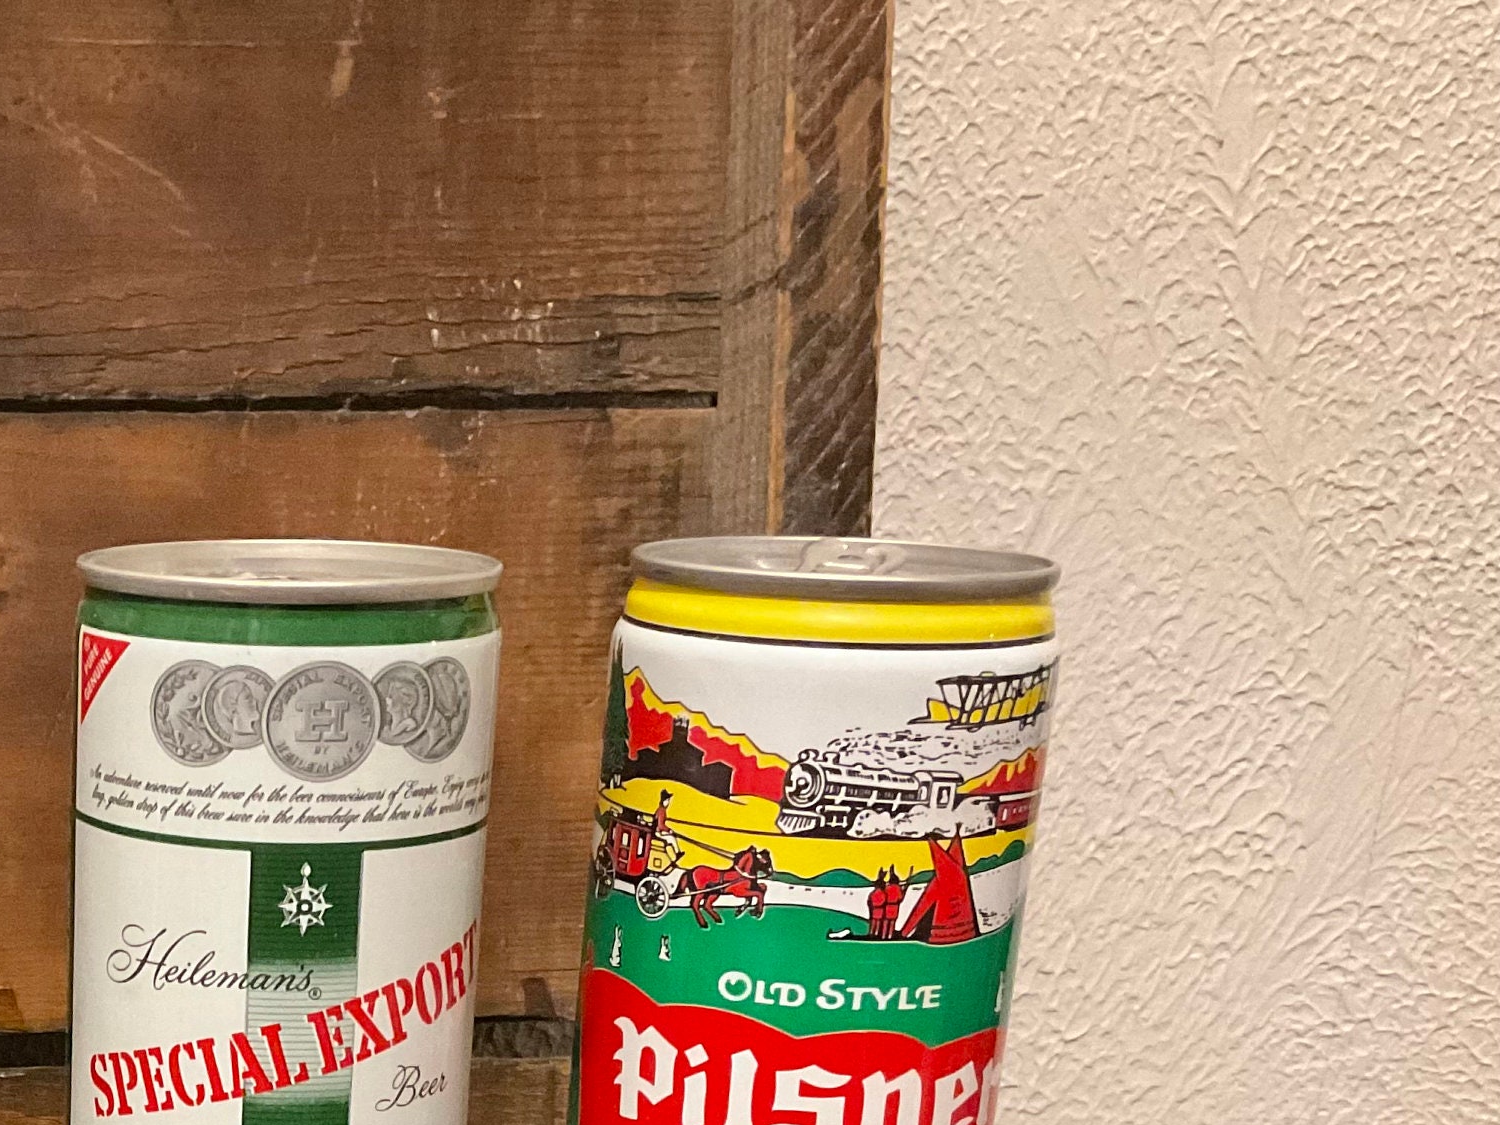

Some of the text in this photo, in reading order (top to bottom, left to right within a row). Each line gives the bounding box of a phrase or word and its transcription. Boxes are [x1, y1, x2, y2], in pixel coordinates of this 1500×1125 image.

[243, 784, 265, 808] for
[267, 785, 288, 802] the
[273, 806, 292, 824] the
[107, 924, 312, 992] Heileman's
[718, 971, 942, 1011] OLD STYLE
[90, 918, 479, 1118] SPECIAL EXPORT
[375, 1064, 448, 1112] Beer
